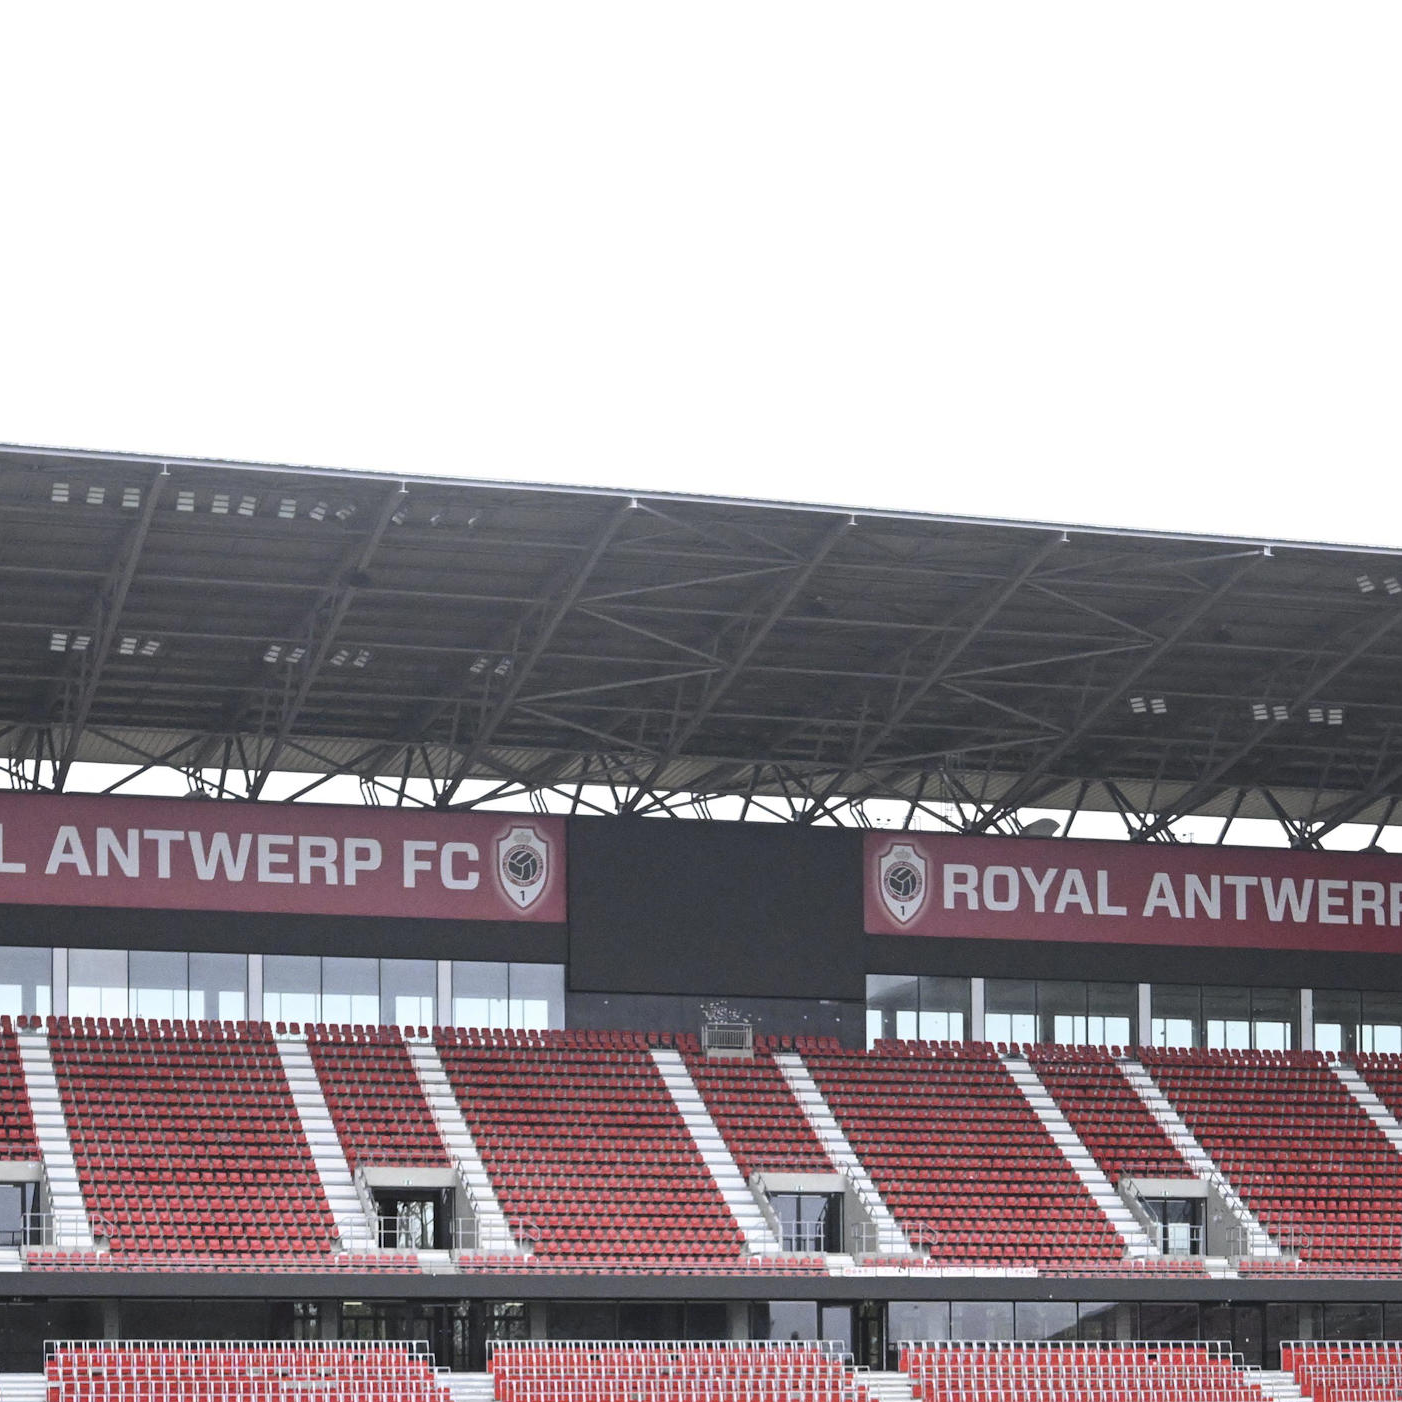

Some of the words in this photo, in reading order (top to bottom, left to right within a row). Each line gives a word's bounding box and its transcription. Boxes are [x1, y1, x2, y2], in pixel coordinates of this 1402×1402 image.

[45, 824, 383, 887] ANTWERP
[403, 840, 481, 891] FC
[942, 863, 1127, 917] ROYAL
